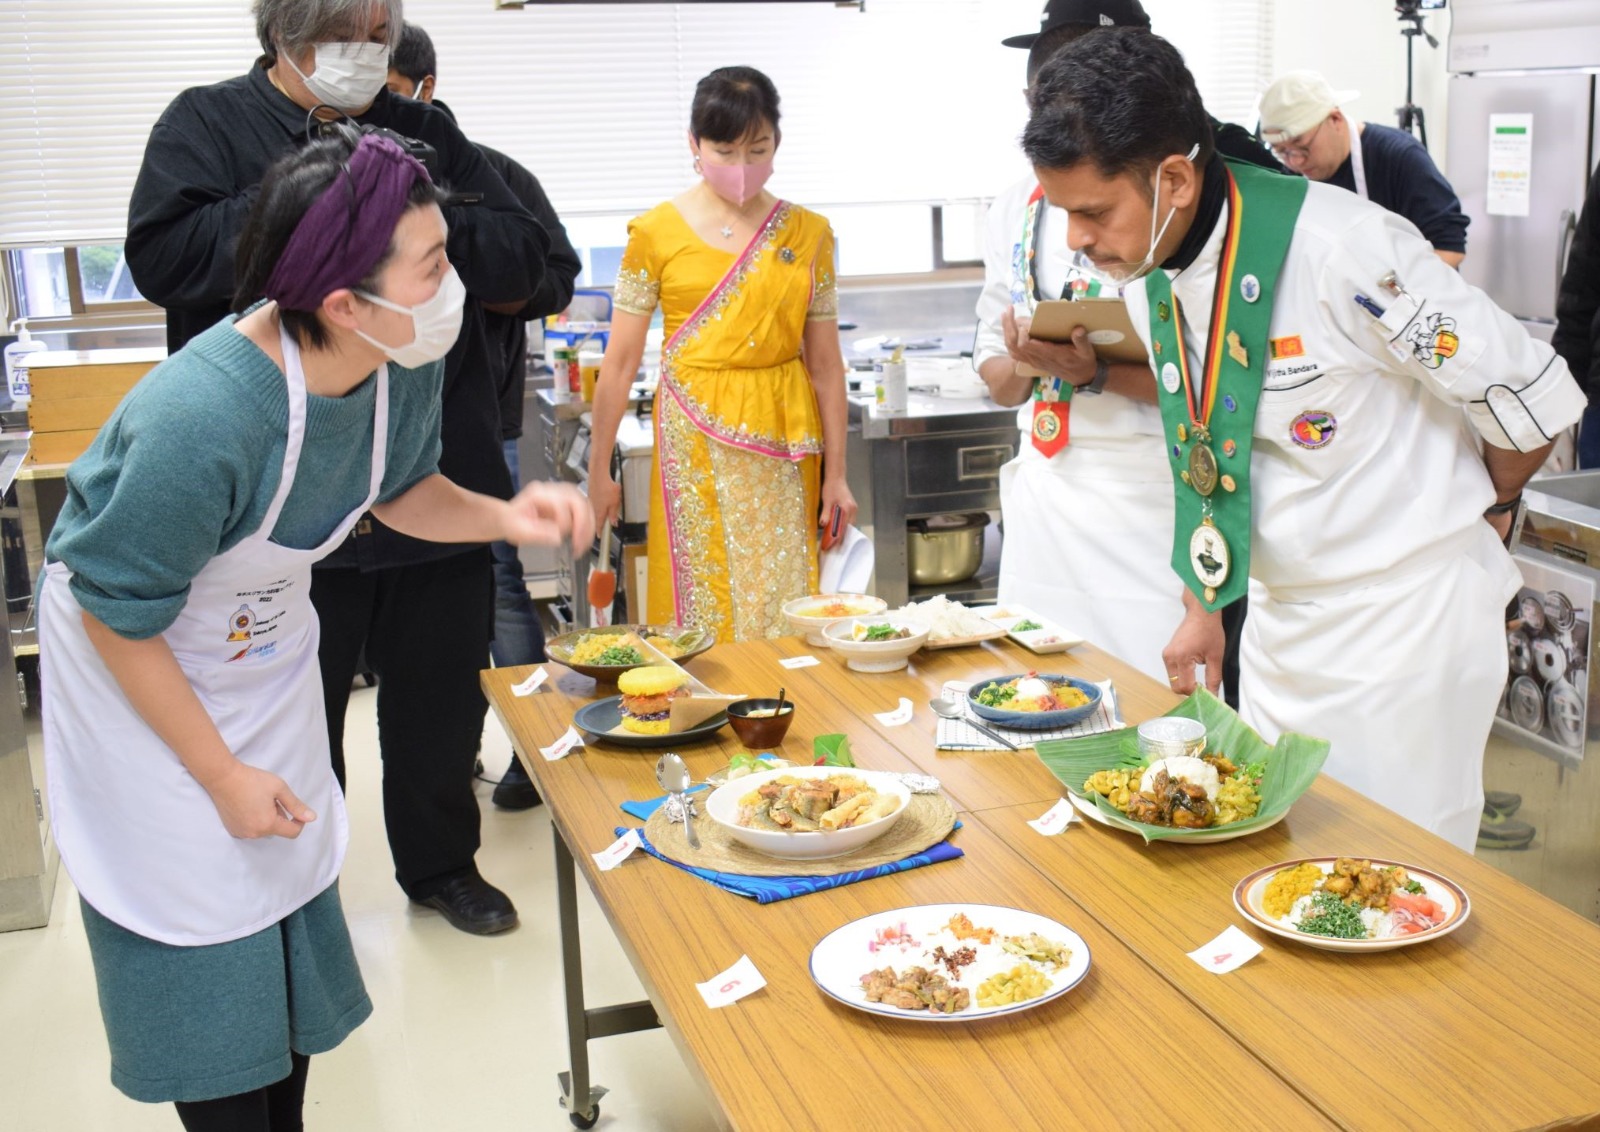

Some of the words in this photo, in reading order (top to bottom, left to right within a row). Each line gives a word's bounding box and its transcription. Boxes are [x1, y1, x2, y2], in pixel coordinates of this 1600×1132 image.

[1287, 364, 1318, 375] Bandara
[1040, 813, 1057, 826] 3
[612, 841, 629, 856] 7
[1213, 952, 1233, 965] 4
[720, 980, 742, 993] 6
